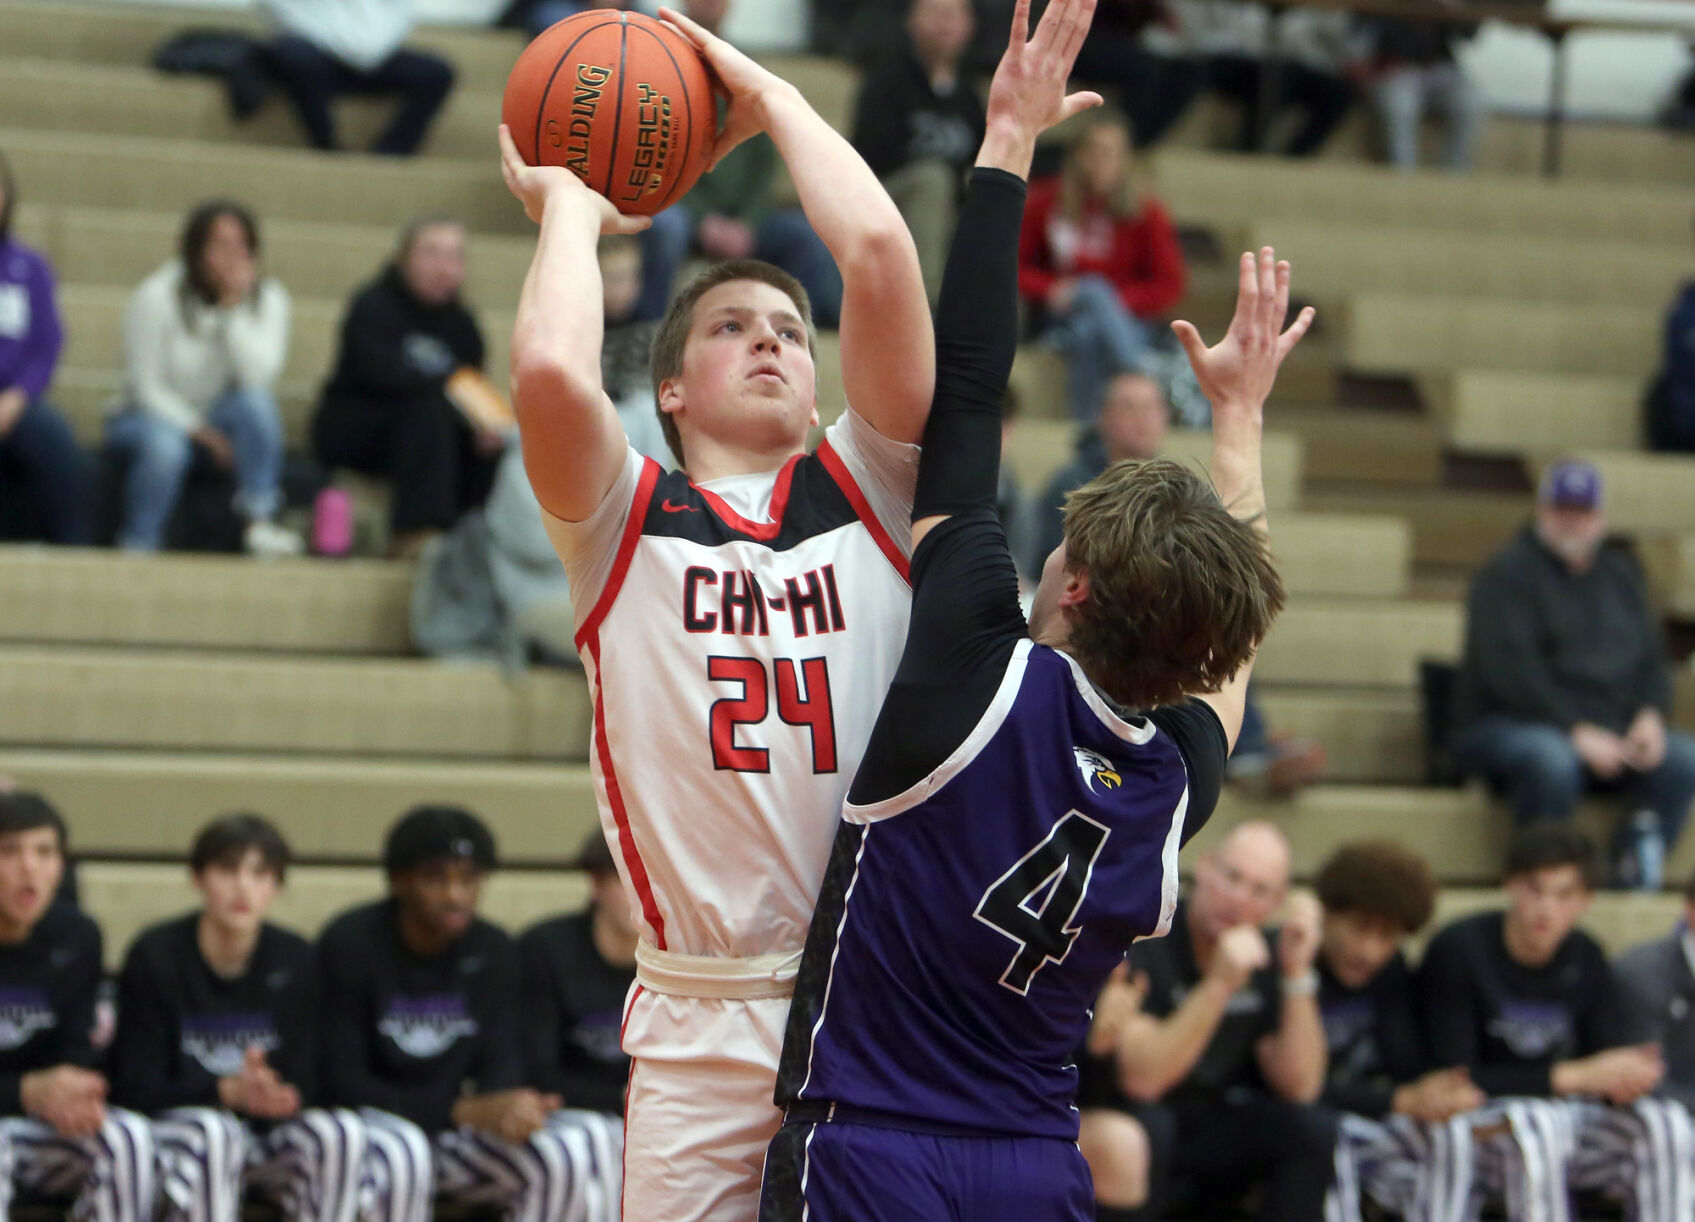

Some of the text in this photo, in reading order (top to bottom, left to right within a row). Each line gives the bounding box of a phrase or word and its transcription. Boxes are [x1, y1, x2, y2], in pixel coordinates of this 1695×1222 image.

[566, 63, 613, 180] ALDING
[622, 82, 658, 202] LEGACY
[683, 563, 846, 638] CHI-HI
[707, 655, 838, 775] 24
[972, 808, 1112, 997] 4
